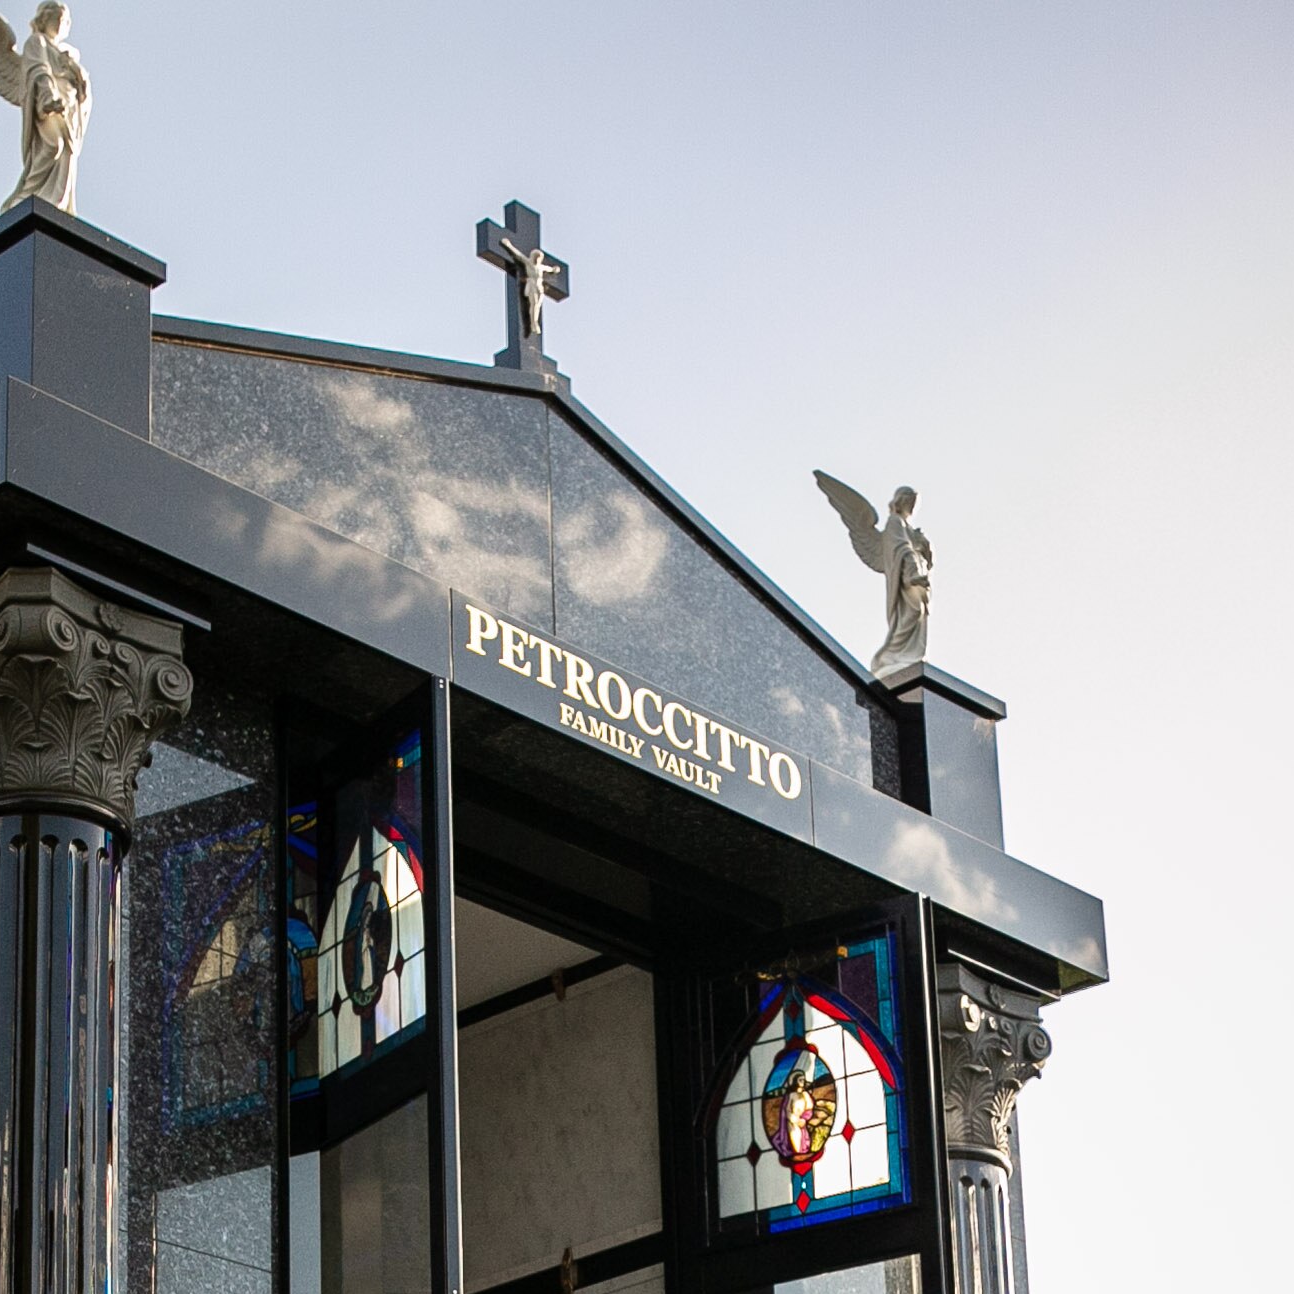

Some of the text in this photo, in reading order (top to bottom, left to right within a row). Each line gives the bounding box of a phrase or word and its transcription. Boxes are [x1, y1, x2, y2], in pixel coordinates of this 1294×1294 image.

[465, 603, 802, 800] PETROCCITTO
[559, 702, 722, 794] FAMILY VAULT
